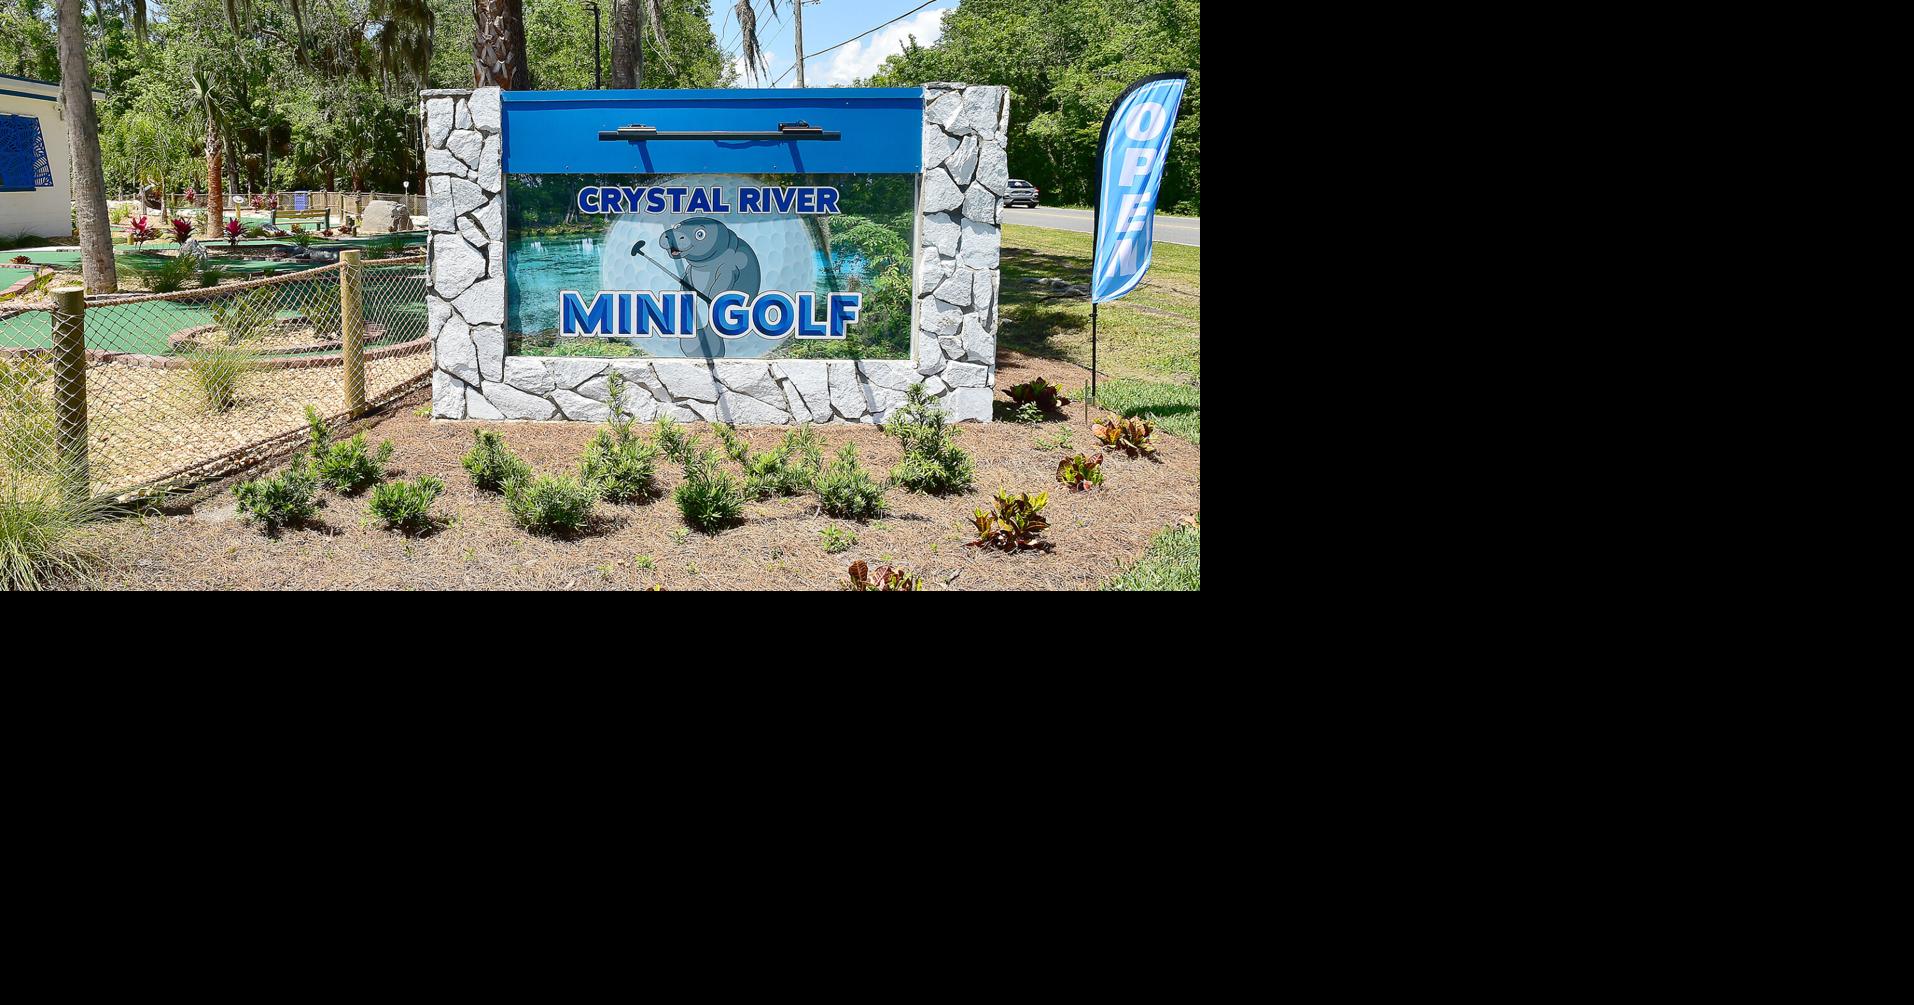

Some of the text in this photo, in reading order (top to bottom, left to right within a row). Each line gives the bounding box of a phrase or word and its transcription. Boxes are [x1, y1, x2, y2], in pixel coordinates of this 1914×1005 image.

[578, 187, 840, 214] CRYSTAL RIVER
[1107, 102, 1167, 278] OPEN
[560, 291, 862, 339] MINI GOLF
